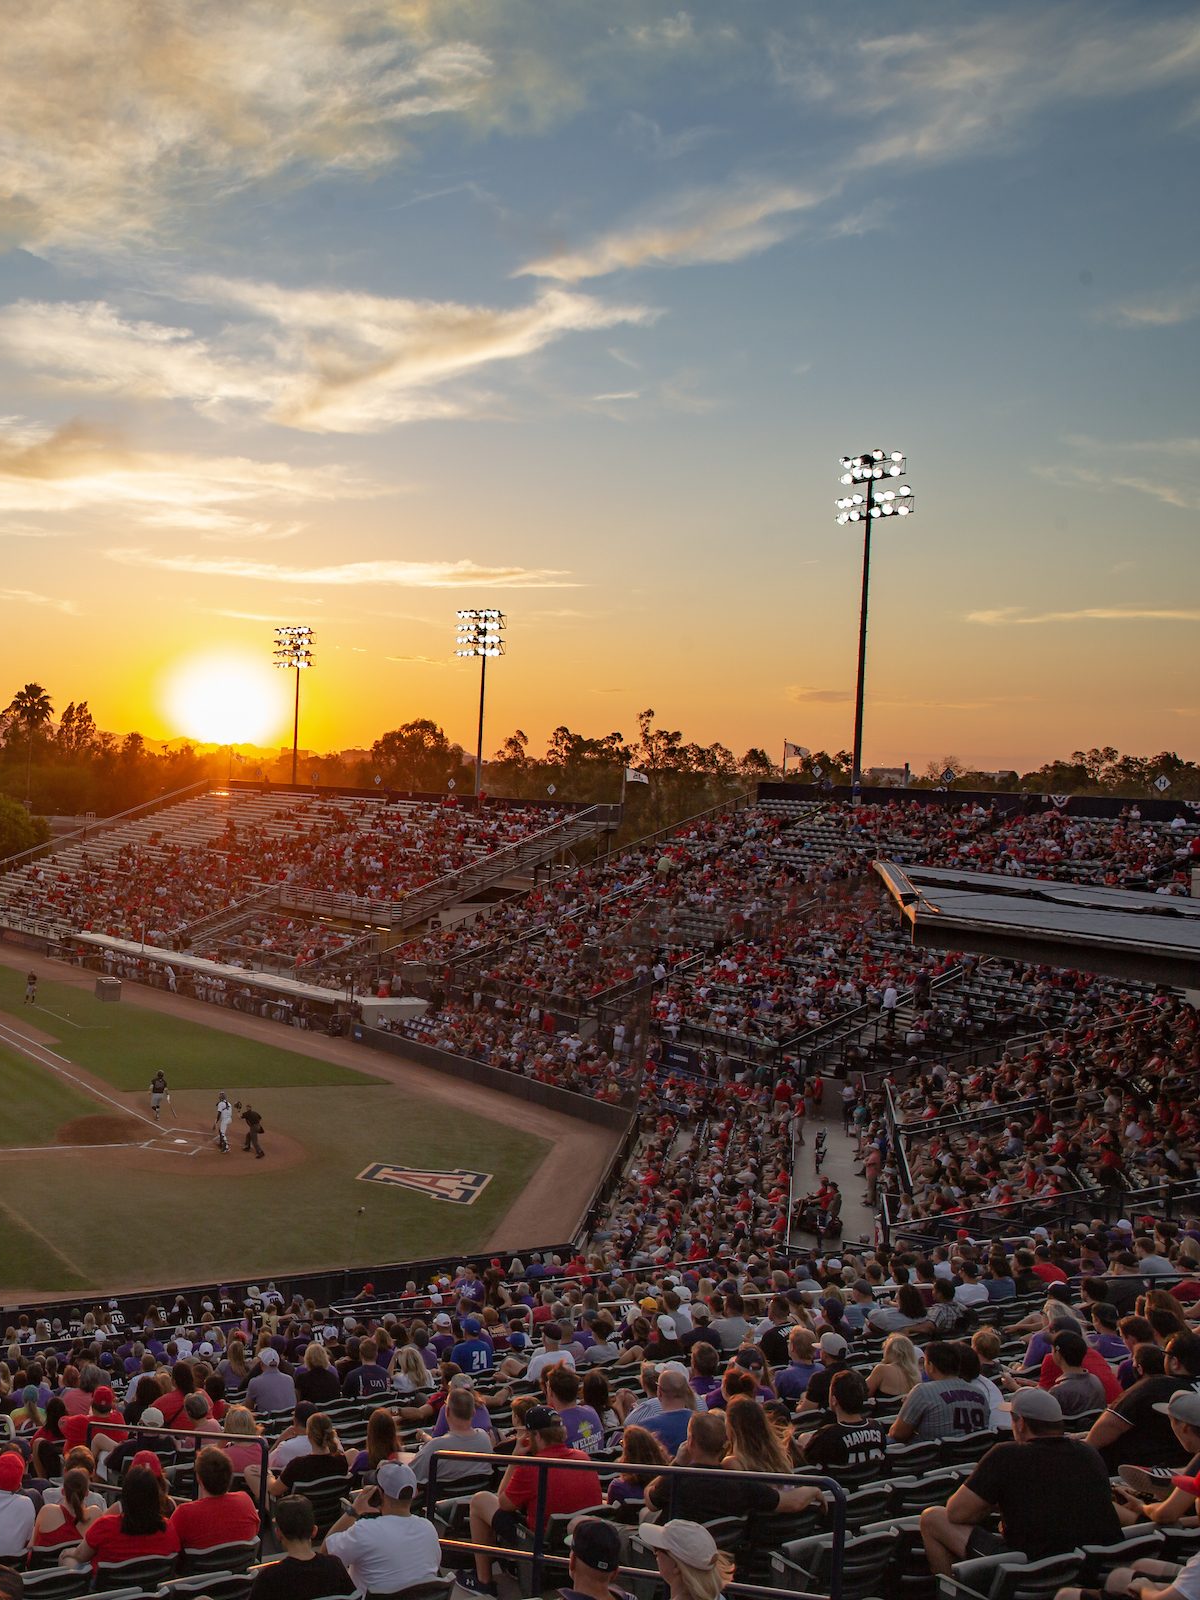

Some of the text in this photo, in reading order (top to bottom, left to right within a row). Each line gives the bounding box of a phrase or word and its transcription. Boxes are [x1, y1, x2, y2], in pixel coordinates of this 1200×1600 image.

[946, 771, 951, 779] G
[1159, 779, 1166, 787] H
[111, 1313, 126, 1324] 49
[472, 1350, 488, 1370] 24
[841, 1429, 882, 1449] HAVOCS
